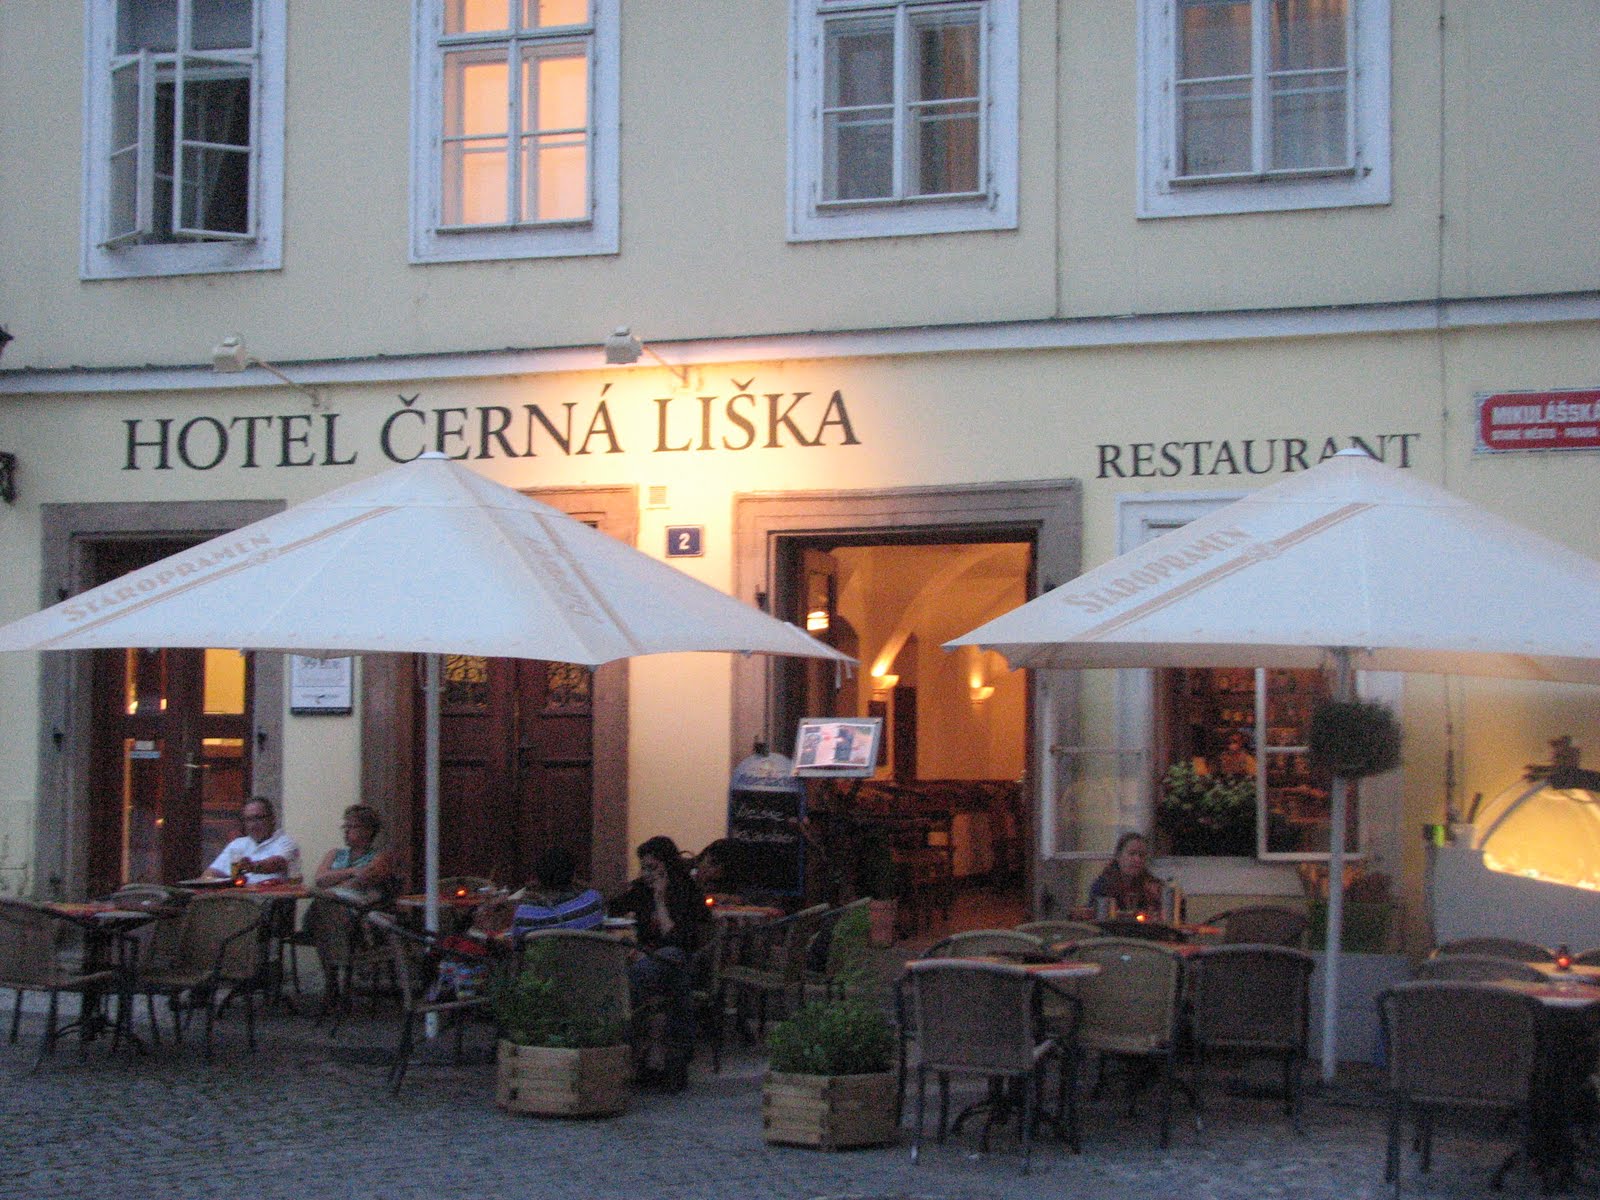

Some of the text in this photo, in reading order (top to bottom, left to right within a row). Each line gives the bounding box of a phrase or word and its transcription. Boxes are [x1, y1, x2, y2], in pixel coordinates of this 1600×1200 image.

[121, 377, 862, 471] HOTEL ČERNÁ LIŠKA
[1096, 433, 1422, 479] RESTAURANT
[678, 532, 691, 550] 2
